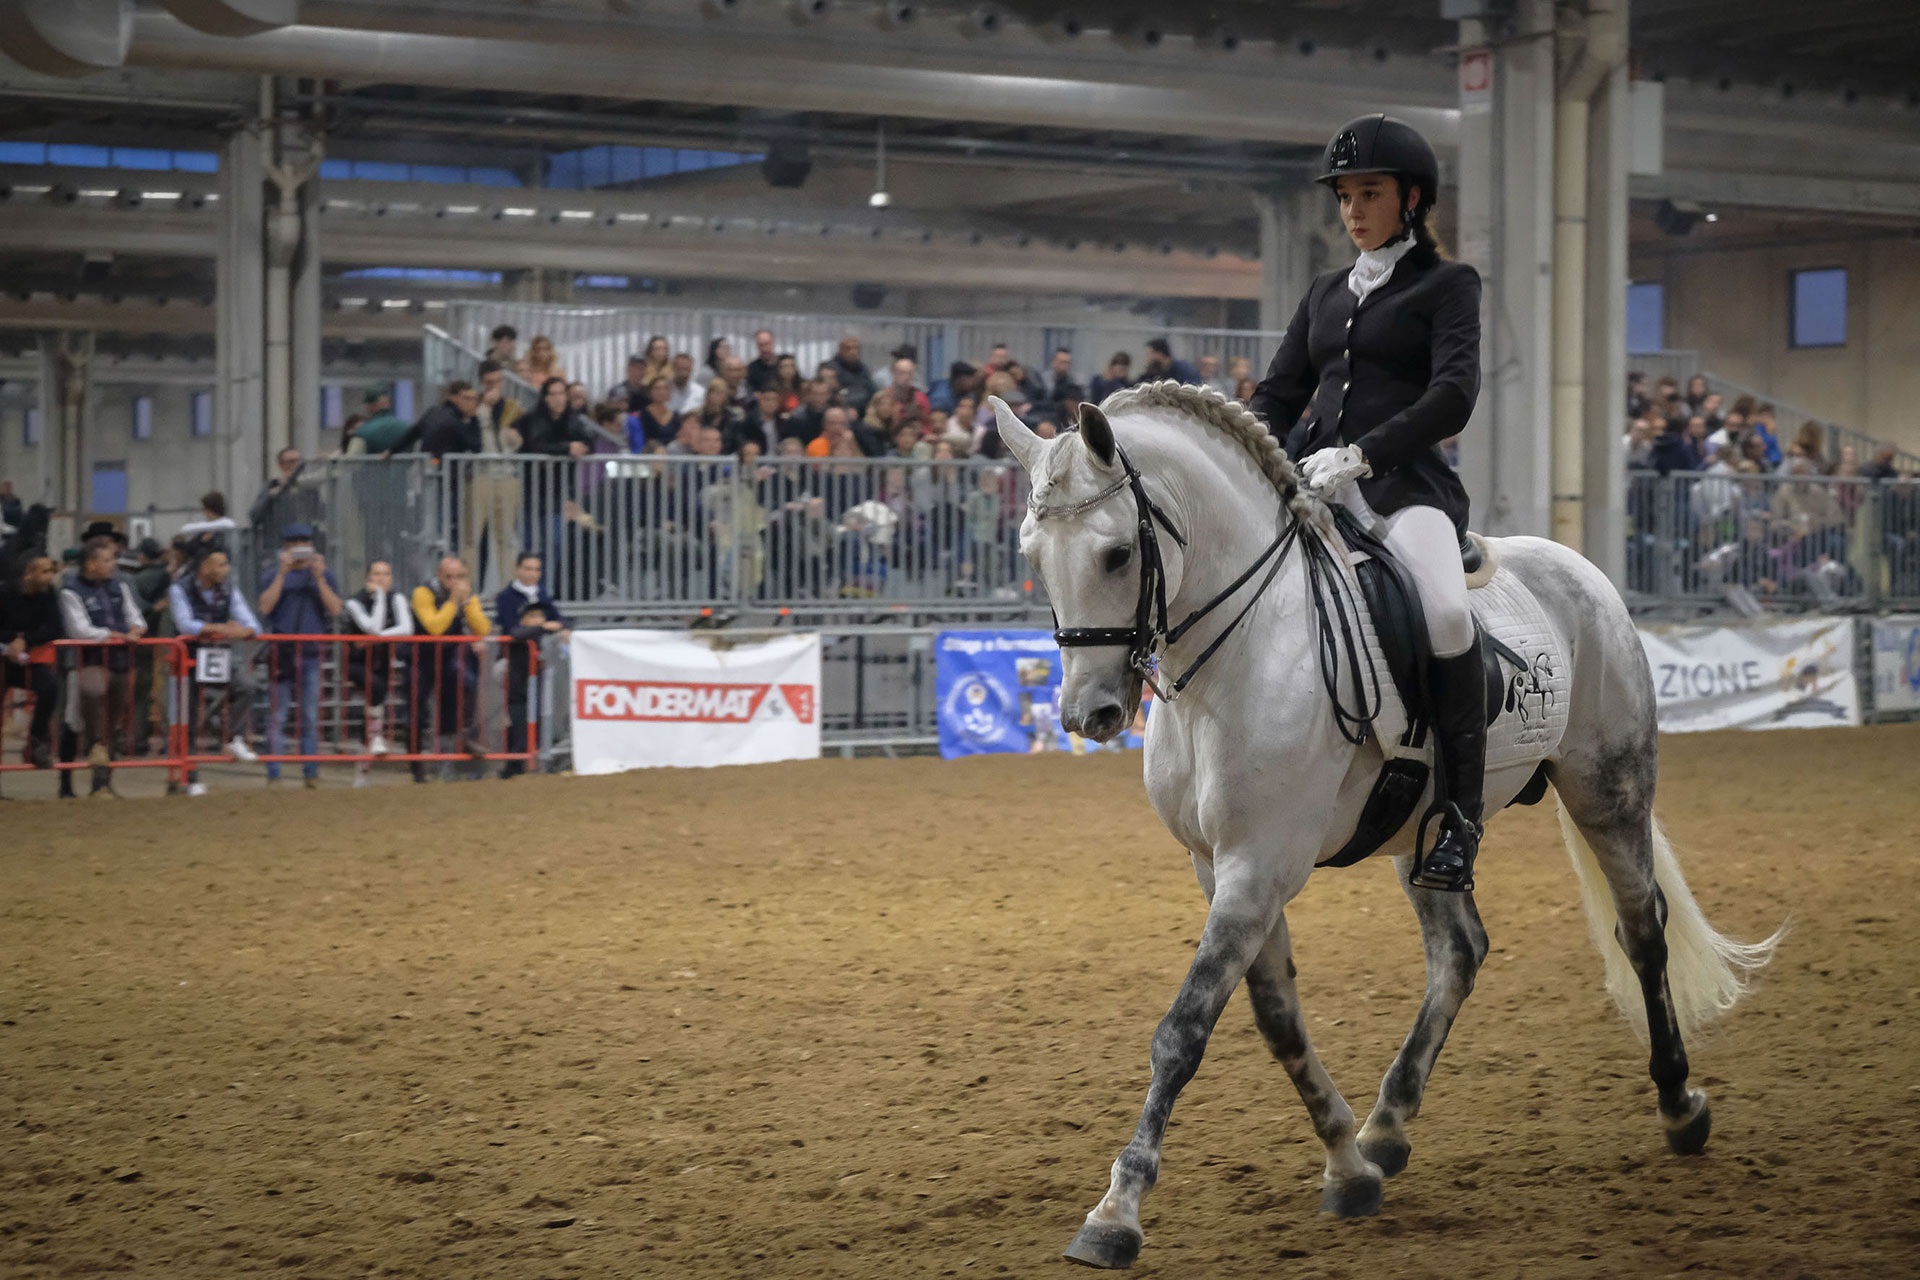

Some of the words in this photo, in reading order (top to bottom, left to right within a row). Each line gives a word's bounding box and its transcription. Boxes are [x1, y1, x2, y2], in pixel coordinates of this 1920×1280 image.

[205, 653, 224, 678] E
[1659, 661, 1760, 697] ZIONE
[583, 684, 759, 719] FONDERMAT
